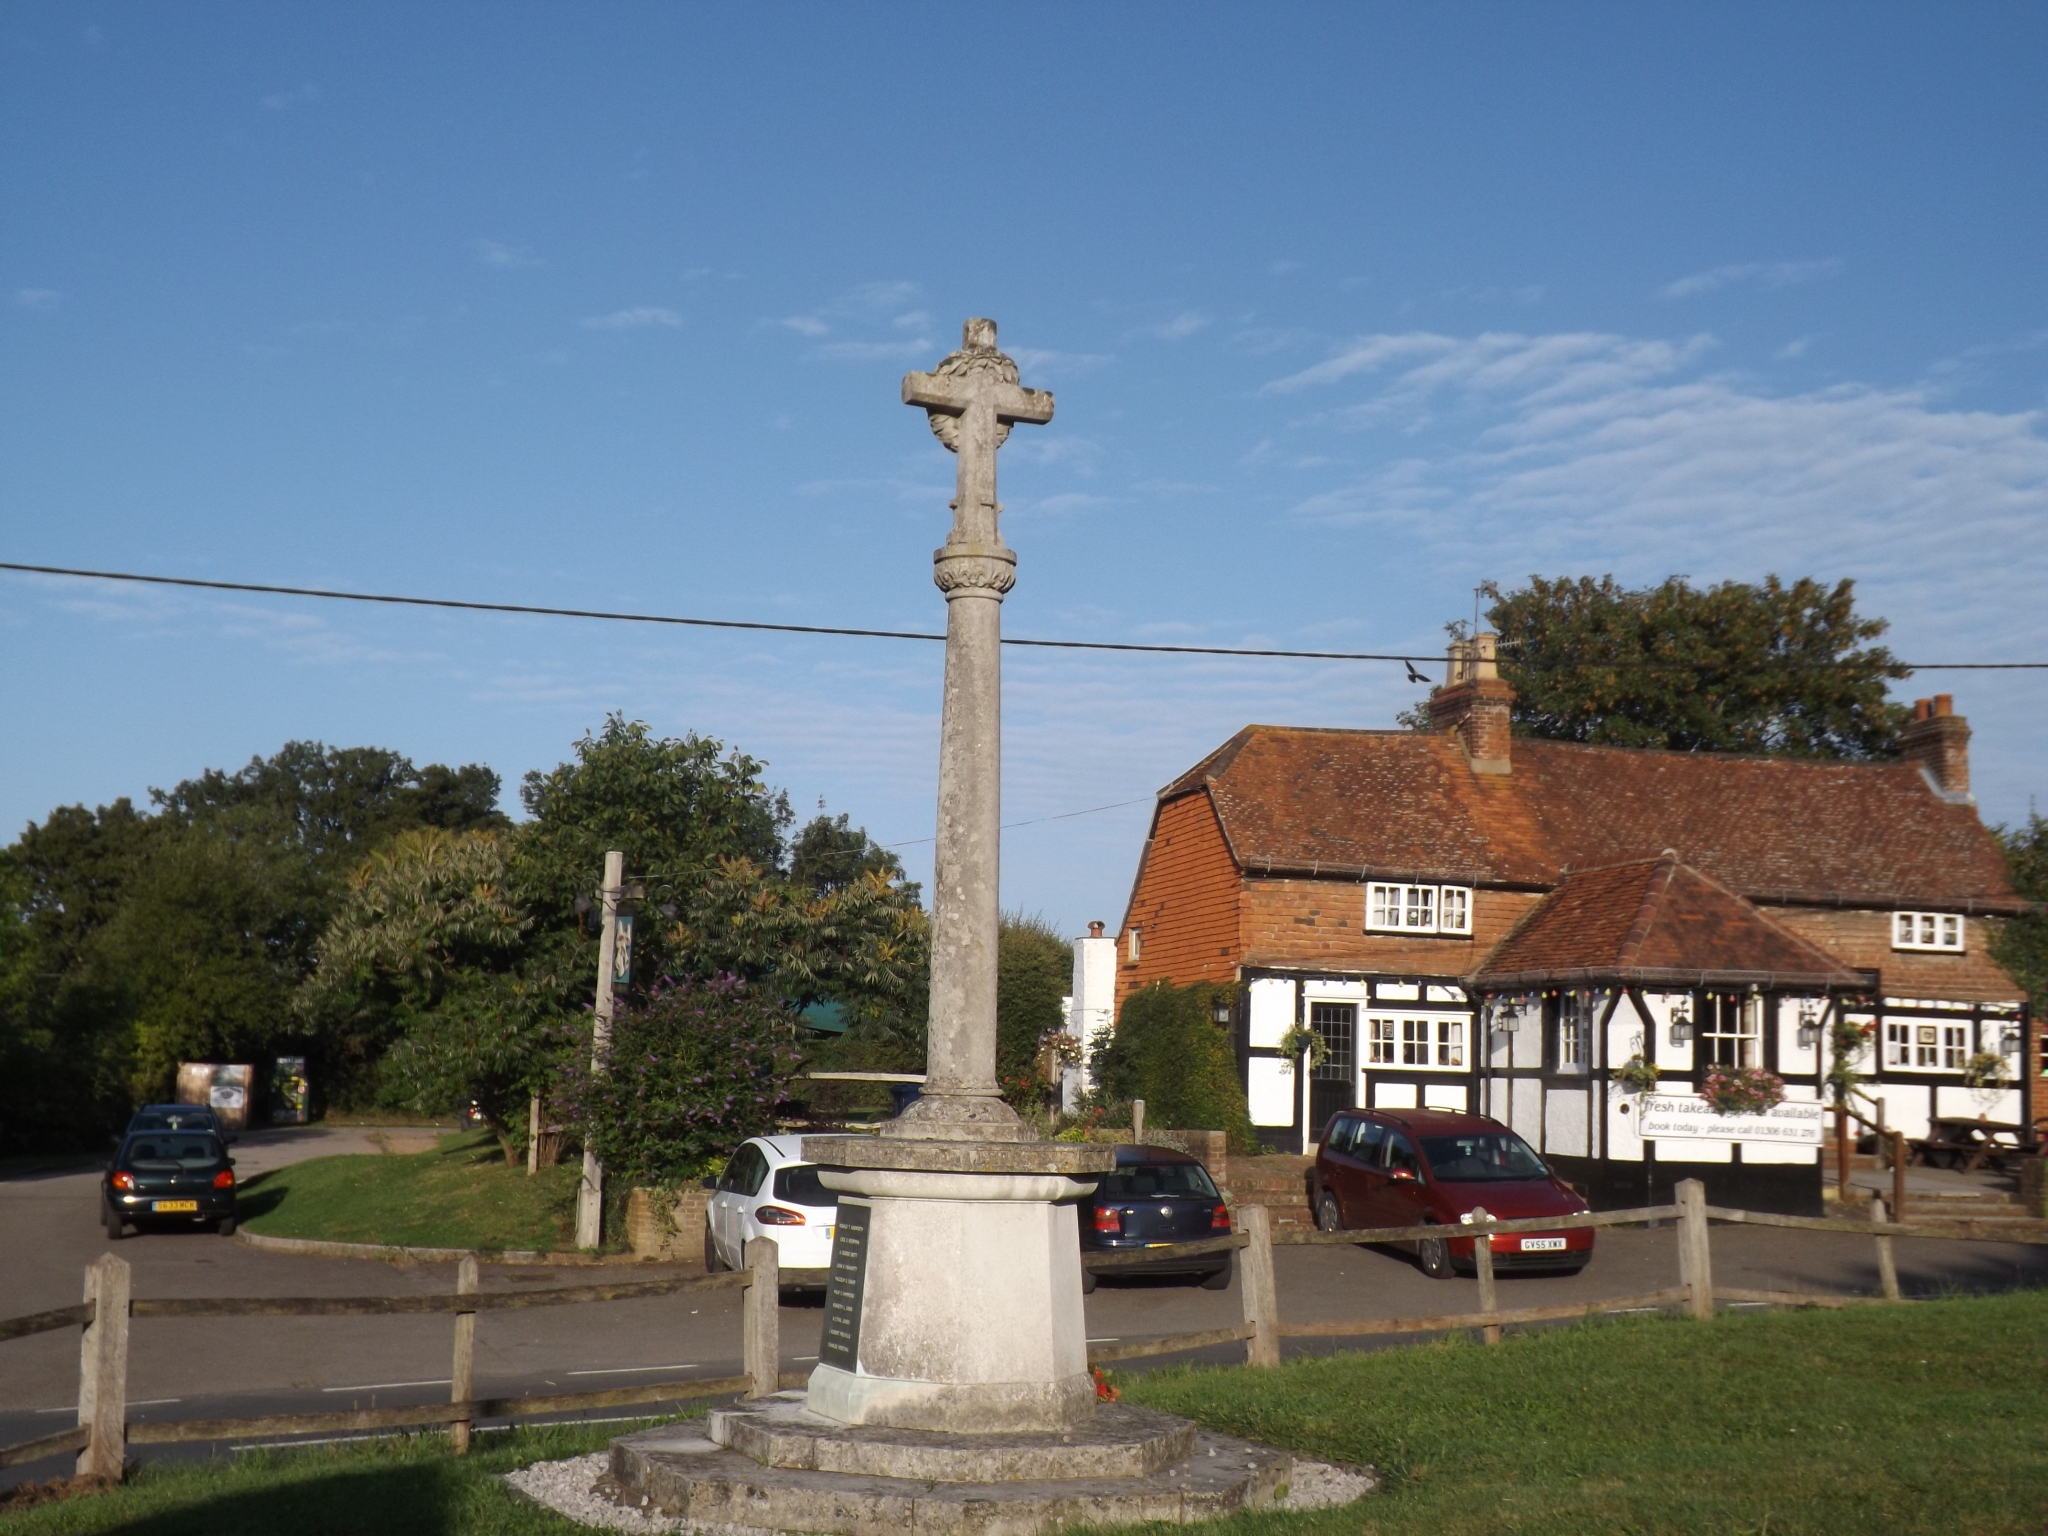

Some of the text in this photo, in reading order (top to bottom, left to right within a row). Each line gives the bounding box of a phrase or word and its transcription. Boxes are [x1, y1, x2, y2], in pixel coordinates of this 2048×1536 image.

[1644, 1100, 1674, 1113] fresh
[1771, 1107, 1820, 1120] available
[1648, 1121, 1671, 1131] book
[1673, 1122, 1699, 1134] today
[1707, 1124, 1735, 1134] please
[1737, 1125, 1753, 1134] call
[1754, 1126, 1780, 1136] 01306
[1782, 1127, 1798, 1136] 631
[1524, 1240, 1546, 1249] GV55
